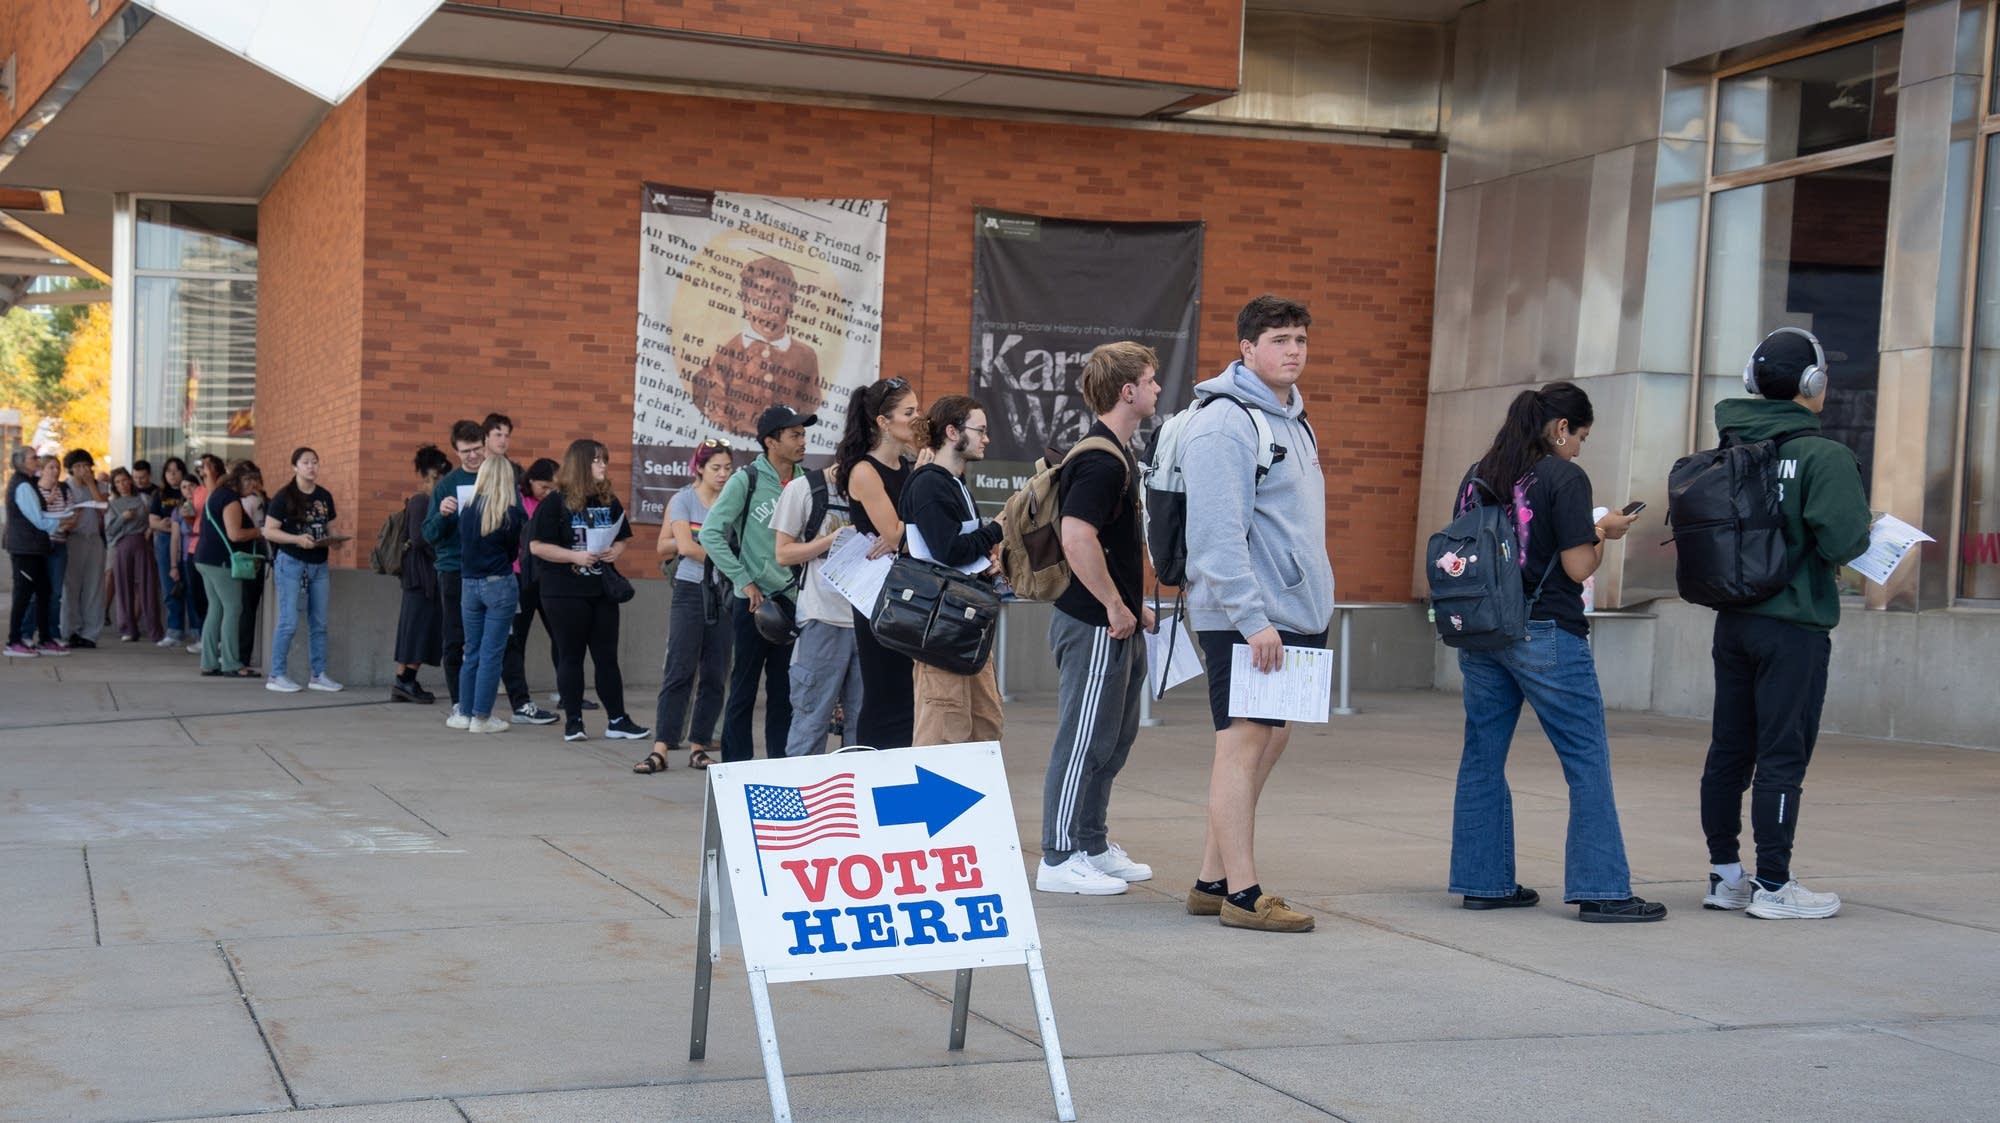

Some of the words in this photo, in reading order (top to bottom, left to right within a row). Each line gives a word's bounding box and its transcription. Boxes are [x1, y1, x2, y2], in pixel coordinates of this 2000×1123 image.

[714, 198, 740, 214] ave
[743, 208, 751, 218] a
[754, 209, 809, 241] Missing
[814, 231, 861, 256] Friend
[866, 252, 881, 263] or
[737, 220, 775, 244] Read
[778, 235, 805, 254] this
[808, 246, 864, 273] Column.
[643, 226, 663, 240] All
[668, 233, 697, 252] Who
[702, 247, 744, 269] Mourn
[861, 303, 880, 317] Mo
[708, 298, 737, 315] umn
[741, 310, 779, 332] Every
[784, 307, 816, 326] Read
[819, 320, 842, 336] this
[826, 306, 880, 332] Husband
[639, 352, 665, 373] ive.
[679, 367, 717, 390] Many
[642, 337, 676, 356] great
[680, 348, 711, 369] land
[716, 363, 744, 380] who
[683, 332, 704, 347] are
[715, 344, 753, 365] many
[760, 361, 811, 384] persons
[815, 377, 853, 397] throu
[639, 375, 697, 405] unhappy
[646, 397, 685, 418] chair.
[655, 416, 673, 432] its
[675, 425, 697, 440] aid
[976, 474, 1009, 489] Kara
[641, 500, 664, 513] Free
[780, 845, 984, 903] VOTE
[1757, 892, 1785, 905] HOKA
[782, 893, 1010, 956] HERE
